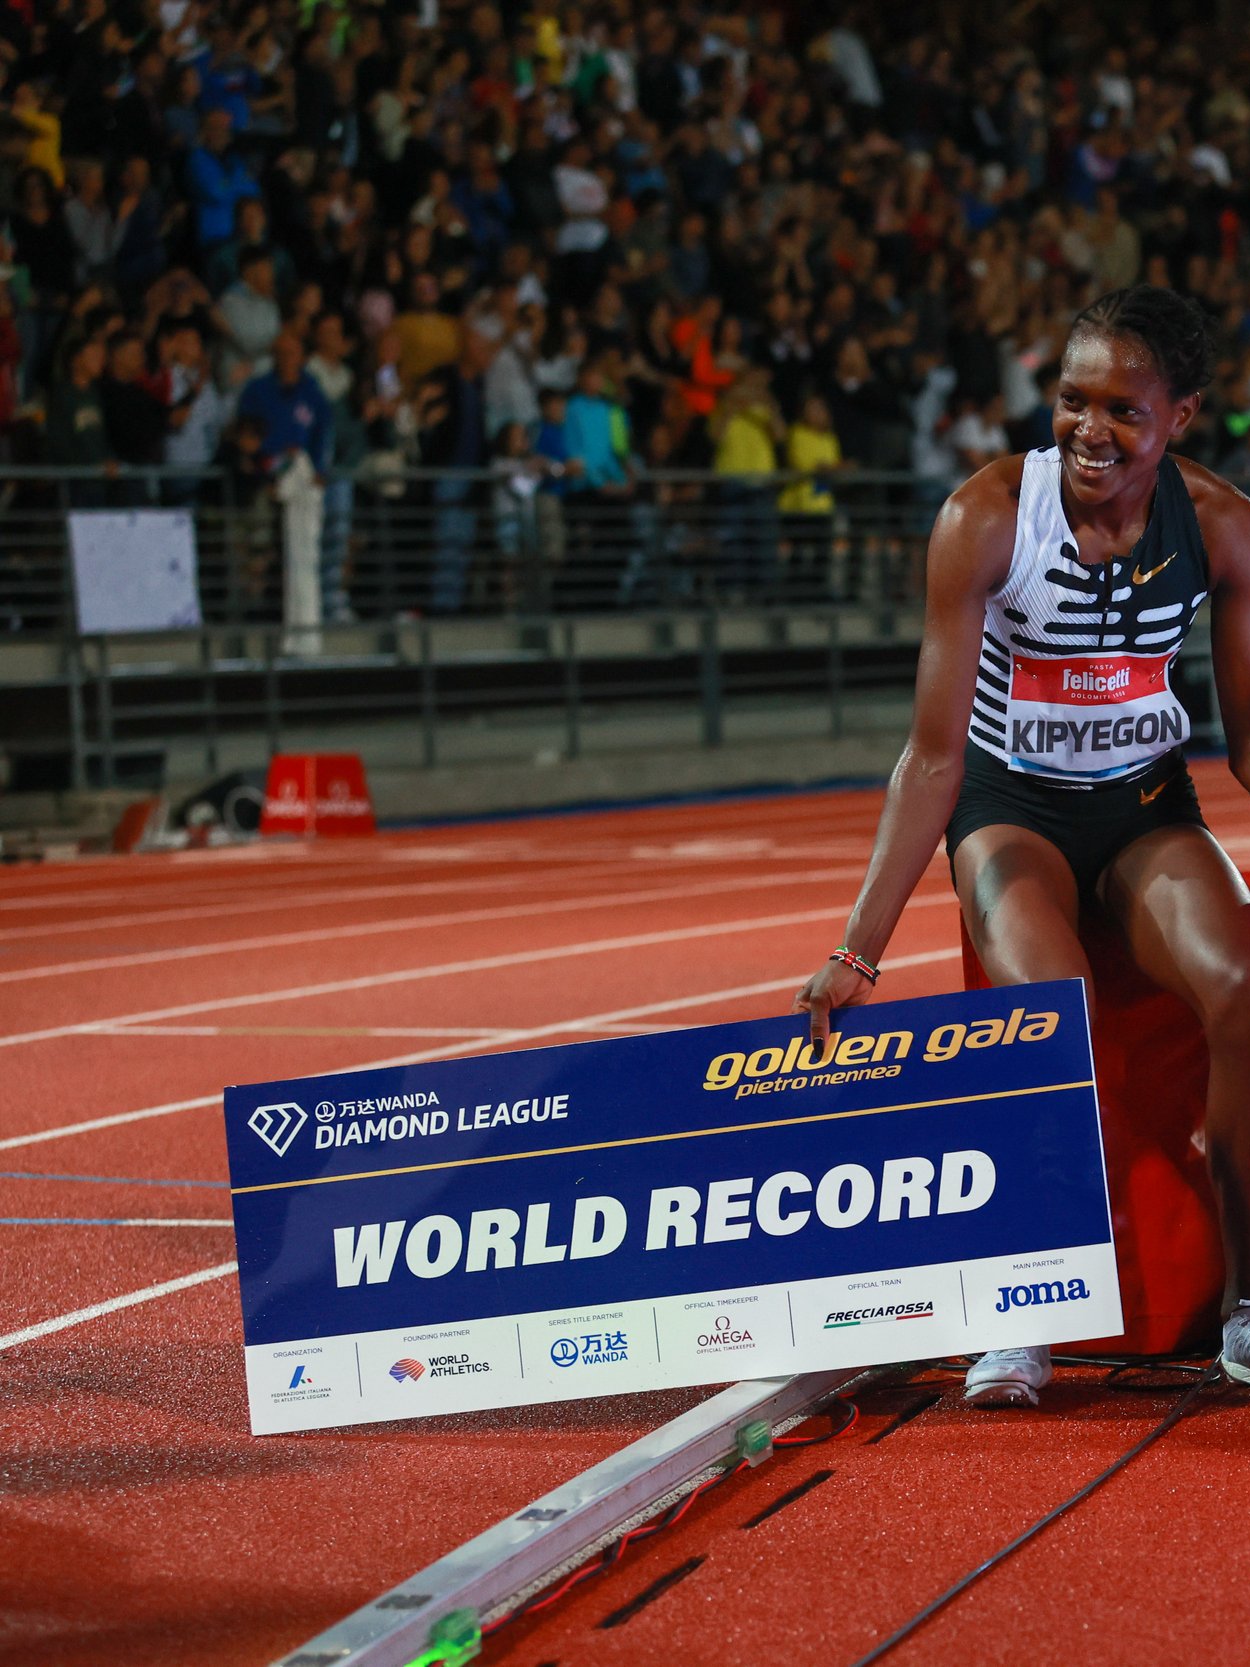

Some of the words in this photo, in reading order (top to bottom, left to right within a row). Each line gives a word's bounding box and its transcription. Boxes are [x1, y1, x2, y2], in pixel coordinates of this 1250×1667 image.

[1063, 667, 1130, 692] felicetti
[1071, 692, 1110, 700] DOLOMITI
[1012, 706, 1182, 753] KIPYEGON
[703, 1031, 913, 1091] golden
[923, 1008, 1060, 1062] gala
[734, 1074, 807, 1100] pietro
[810, 1065, 902, 1087] mennea
[315, 1110, 449, 1149] DIAMOND
[458, 1094, 570, 1132] LEAGUE
[333, 1196, 627, 1288] WORLD
[645, 1149, 997, 1251] RECORD
[1013, 1262, 1031, 1270] MAIN
[1032, 1259, 1064, 1268] PARTNER
[847, 1281, 879, 1290] OFFICIAL
[881, 1279, 902, 1287] TRAIN
[684, 1302, 715, 1310] OFFICIAL
[717, 1296, 759, 1306] TIMEKEEPER
[548, 1318, 572, 1326] SERIES
[573, 1315, 591, 1323] TITLE
[592, 1312, 623, 1321] PARTNER
[826, 1301, 934, 1323] FRECCIAROSSA
[403, 1333, 438, 1342] FOUNDING
[440, 1329, 470, 1338] PARTNER
[580, 1331, 628, 1353] 万达
[697, 1329, 753, 1347] OMEGA
[273, 1347, 323, 1358] ORGANIZATION
[723, 1343, 756, 1351] TIMEKEEPER
[428, 1354, 469, 1366] WORLD
[582, 1351, 628, 1365] WANDA
[271, 1390, 306, 1398] FEDERAZIONE
